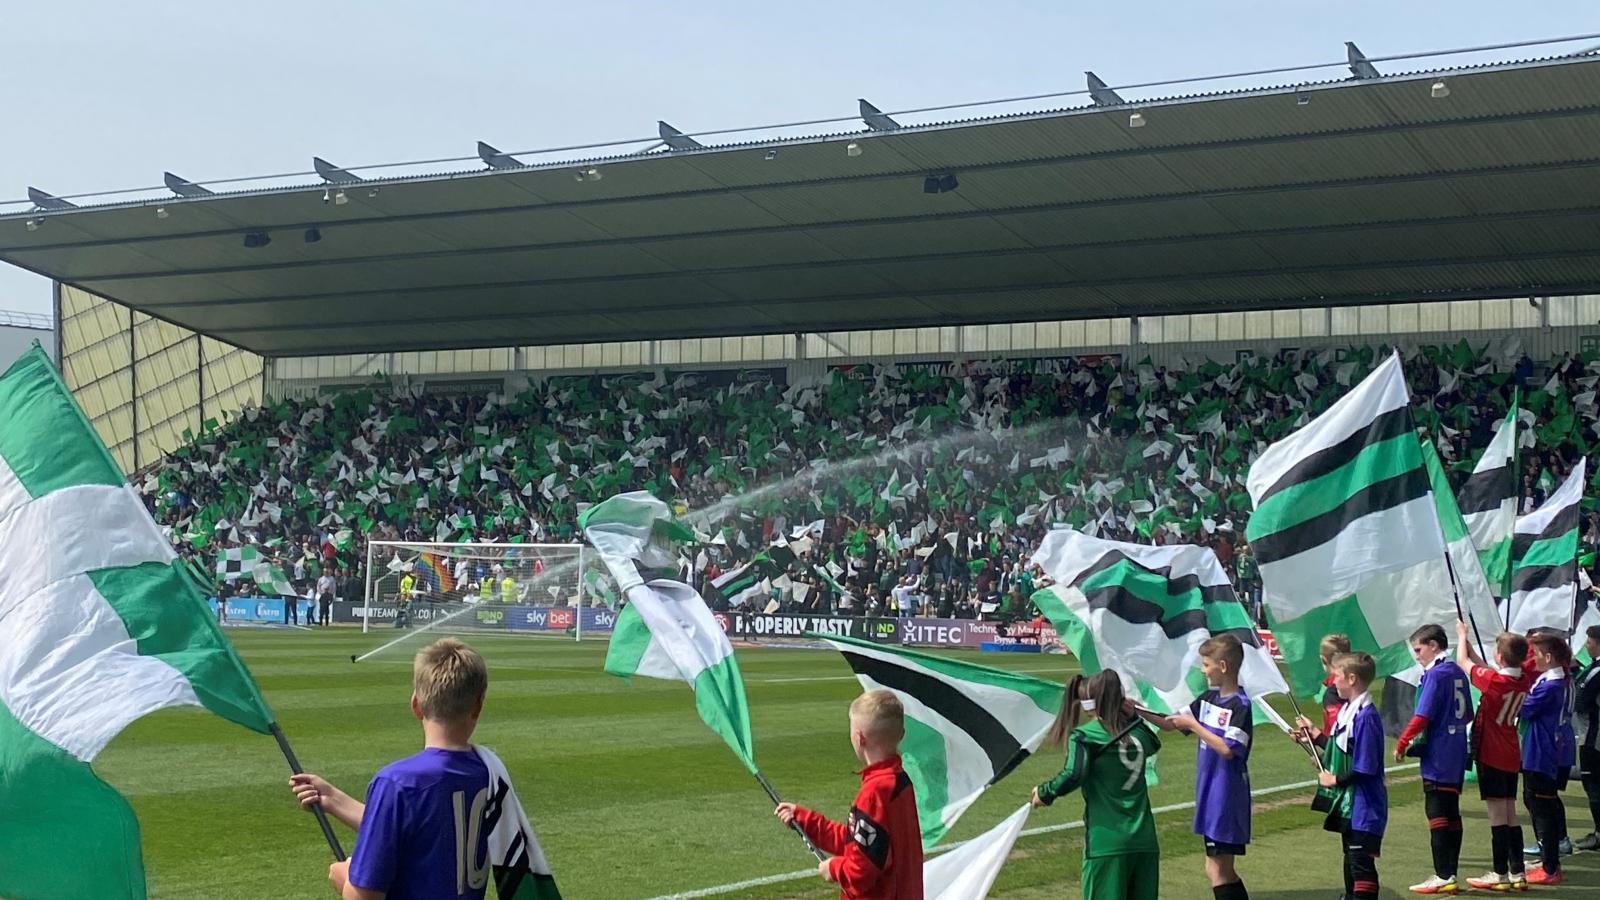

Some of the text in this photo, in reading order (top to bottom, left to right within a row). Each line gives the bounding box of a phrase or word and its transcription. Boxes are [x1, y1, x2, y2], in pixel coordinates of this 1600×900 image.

[526, 609, 570, 626] sky bet
[595, 612, 615, 628] sky
[811, 617, 853, 637] TASTY
[917, 625, 962, 643] ITEC
[1453, 679, 1466, 720] 5
[1495, 690, 1526, 727] 10
[1118, 735, 1145, 791] 9
[452, 787, 491, 896] 10
